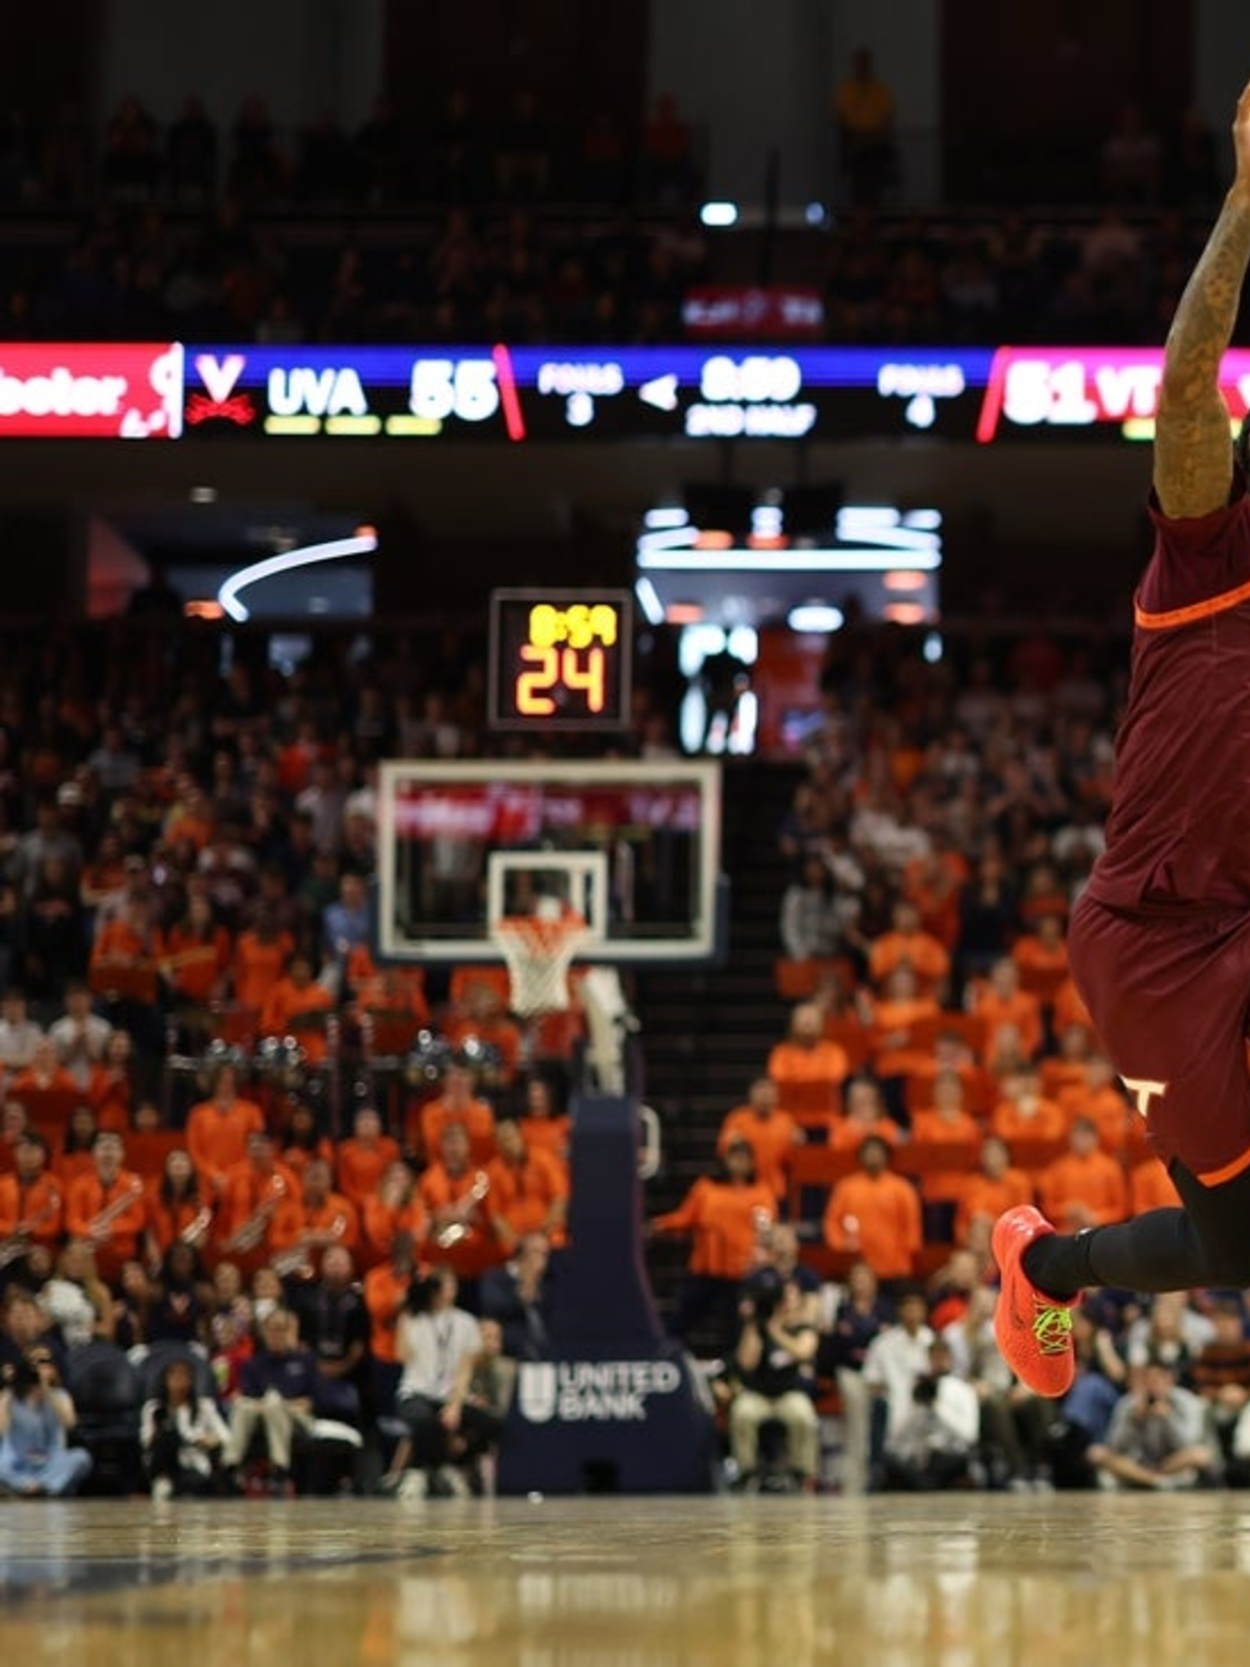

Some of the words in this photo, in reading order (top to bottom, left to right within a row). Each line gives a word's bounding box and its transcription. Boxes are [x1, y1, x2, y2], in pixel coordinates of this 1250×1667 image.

[267, 367, 367, 415] UVA
[409, 359, 499, 421] 55
[1004, 360, 1097, 424] 51
[516, 645, 604, 715] 24
[559, 1361, 681, 1393] UNITED
[559, 1388, 647, 1421] BANK
